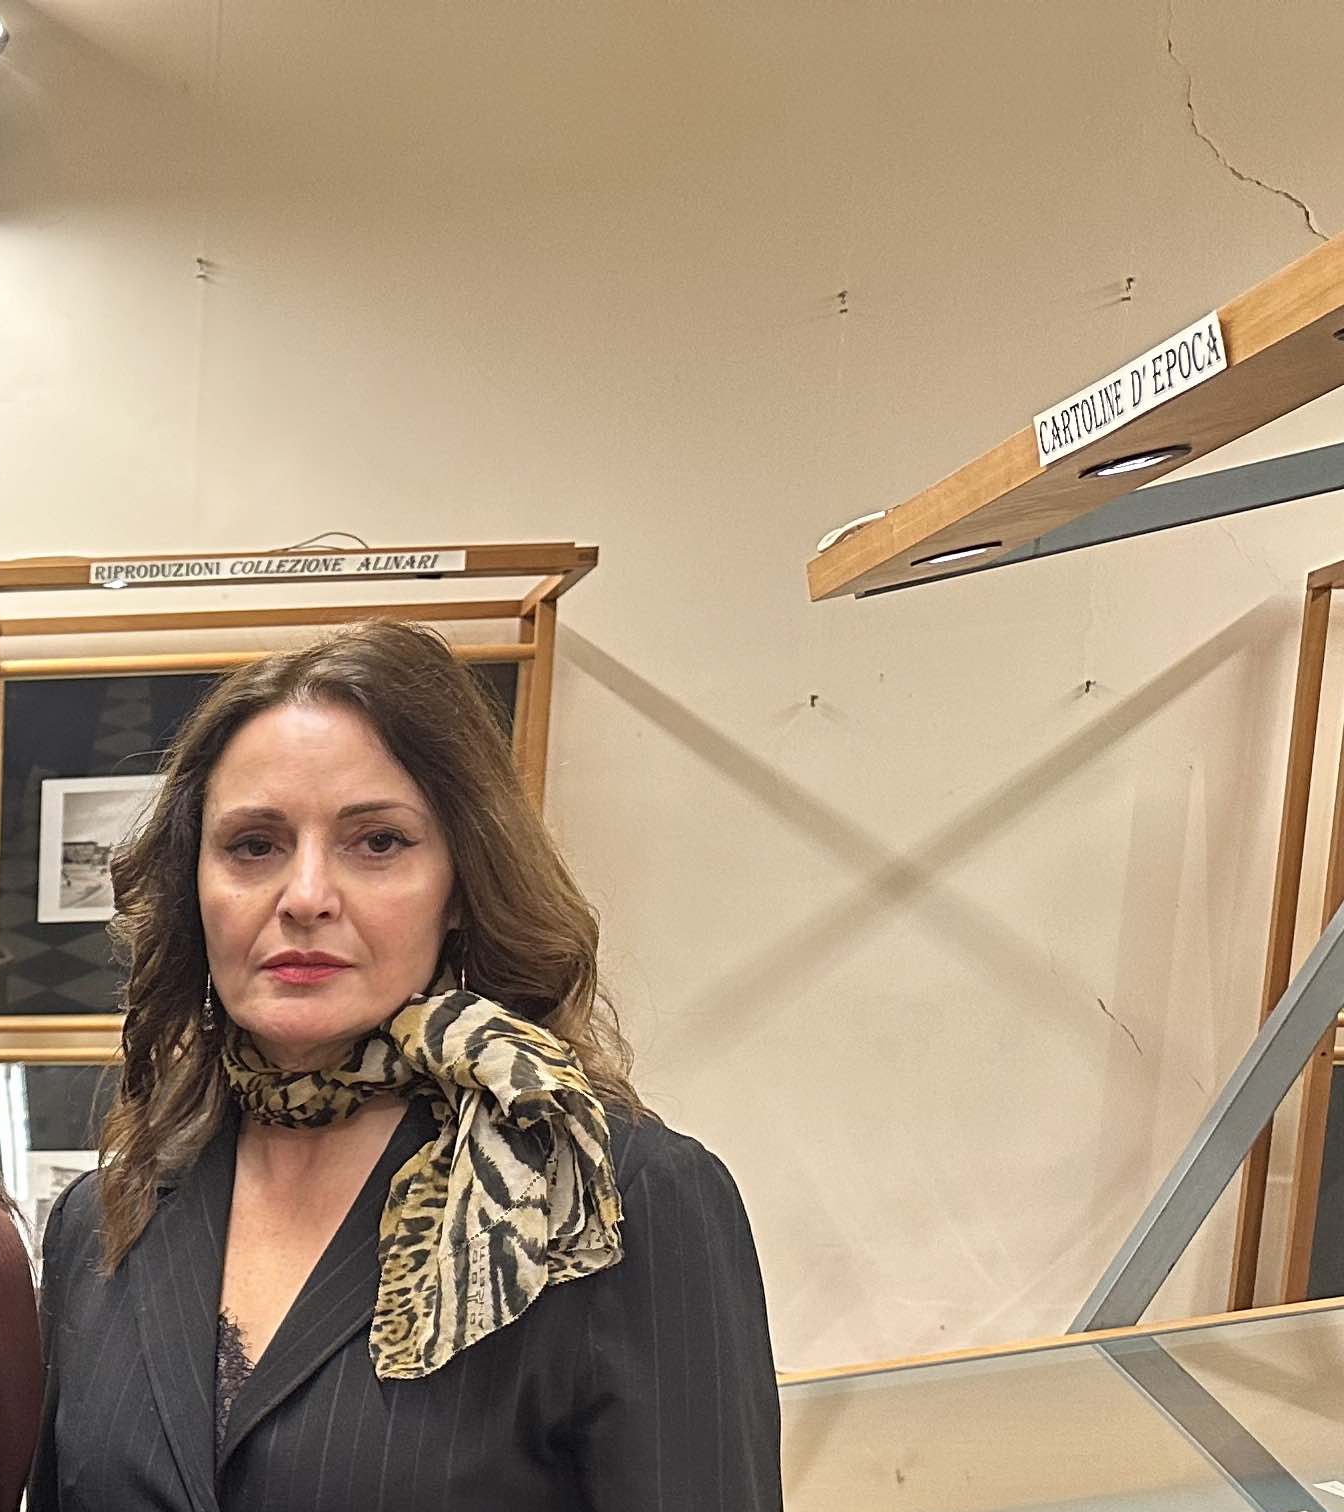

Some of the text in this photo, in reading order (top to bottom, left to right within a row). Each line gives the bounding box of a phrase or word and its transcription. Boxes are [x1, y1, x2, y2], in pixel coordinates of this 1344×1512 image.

[1039, 379, 1124, 455] CARTOLINE
[94, 554, 440, 580] RIPRODUZIONI COLLEZIONE ALINARI
